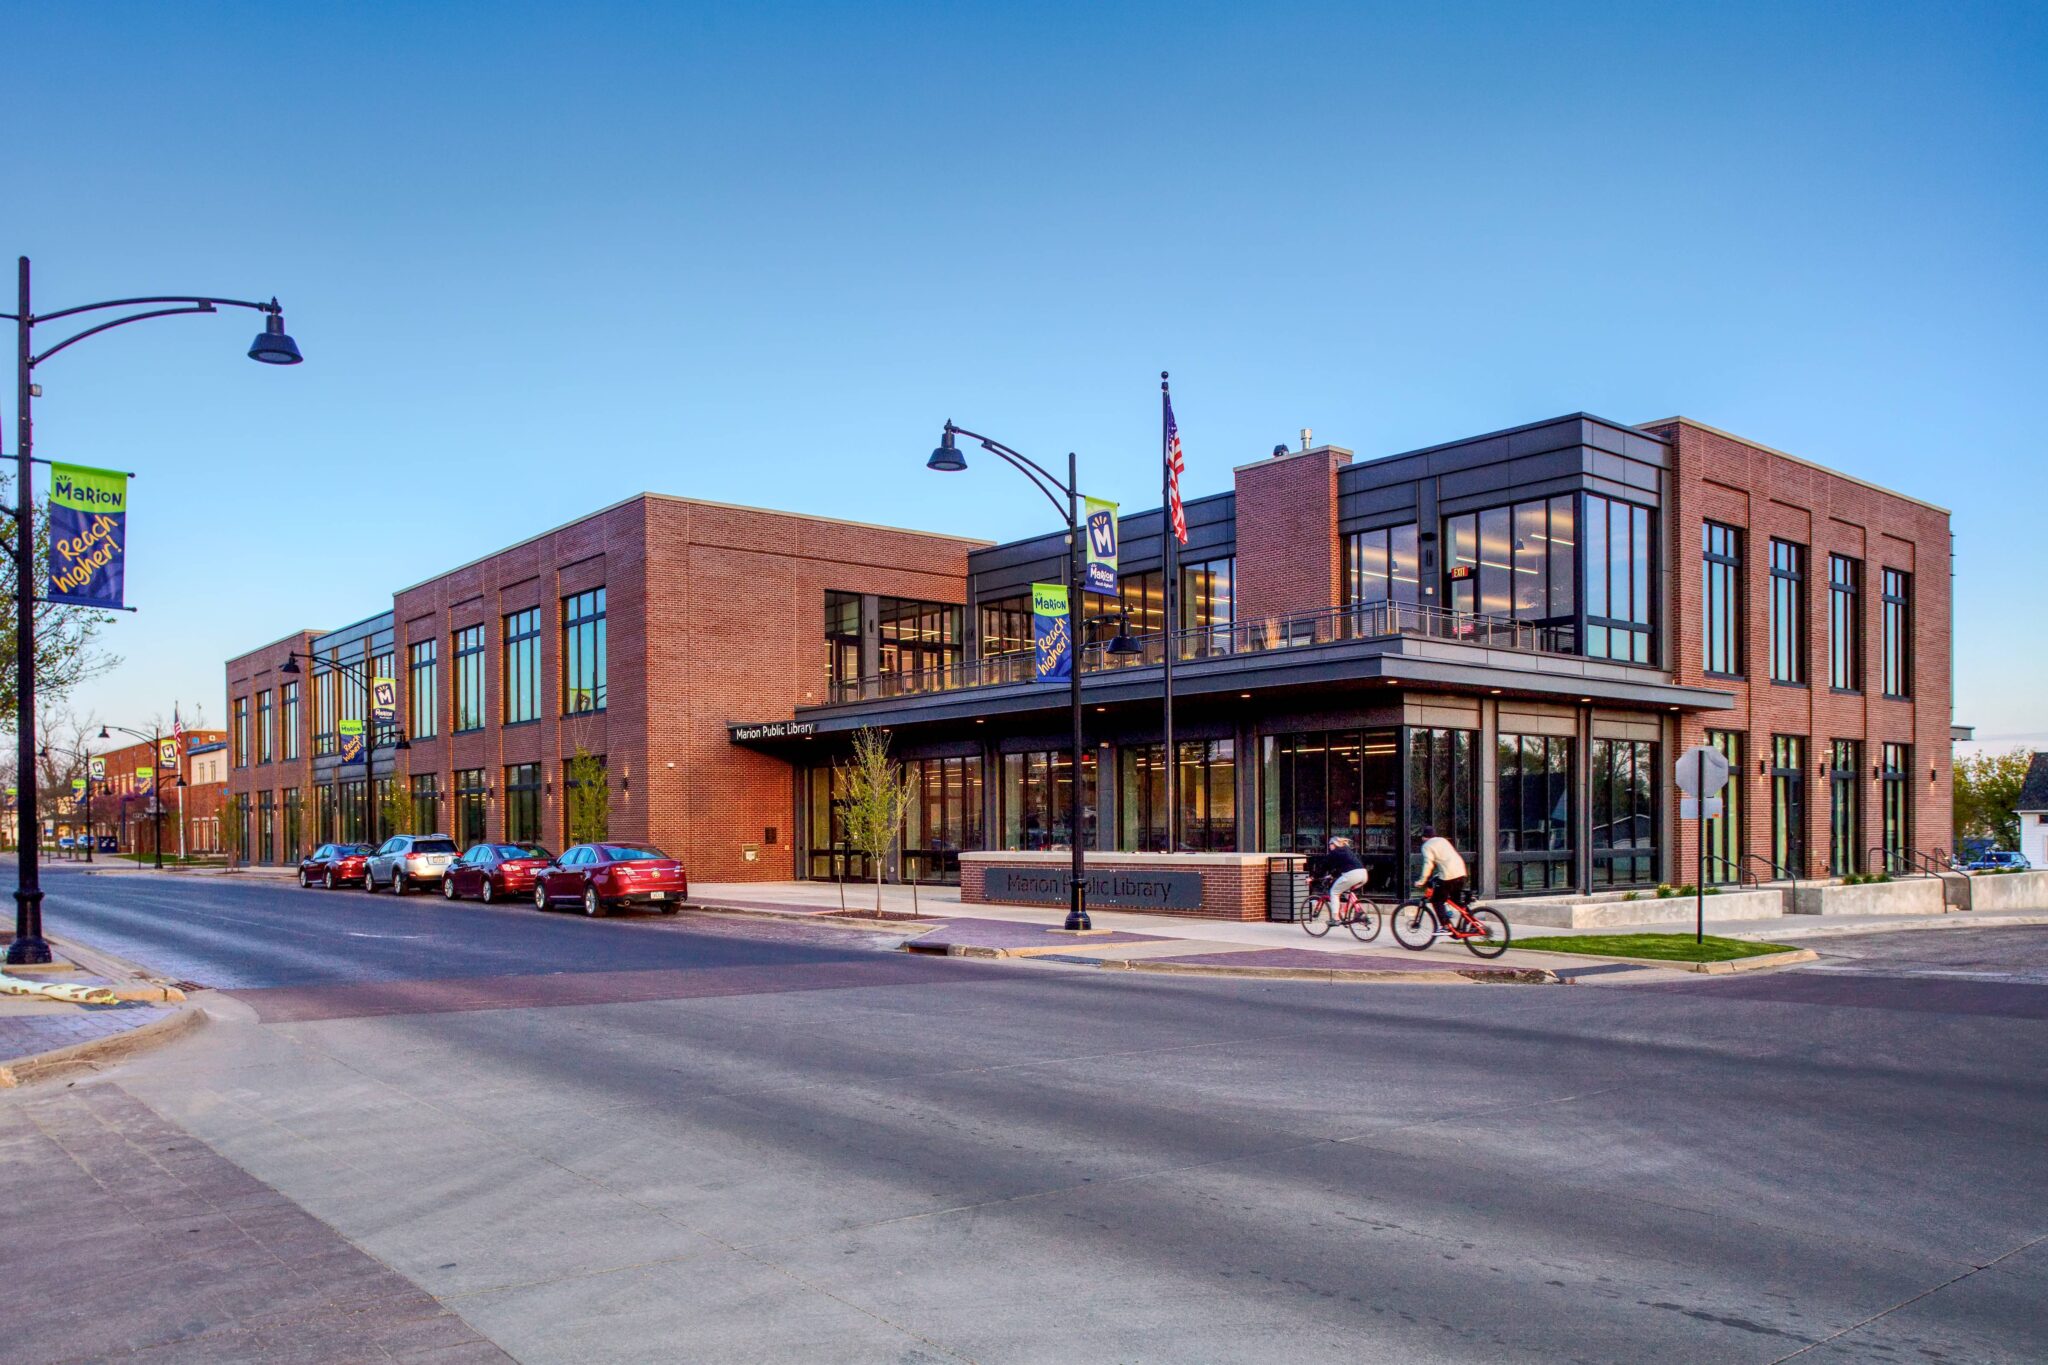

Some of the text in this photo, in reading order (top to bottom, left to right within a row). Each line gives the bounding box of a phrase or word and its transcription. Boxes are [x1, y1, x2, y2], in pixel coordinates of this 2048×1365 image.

[57, 514, 118, 561] Reach
[52, 535, 122, 593] higher!
[1454, 568, 1465, 577] EXIT
[1038, 617, 1067, 653] Reach
[1037, 631, 1070, 676] higher!
[736, 722, 814, 740] Marion Public Library
[1008, 873, 1058, 893] Marion
[1114, 877, 1172, 903] Library
